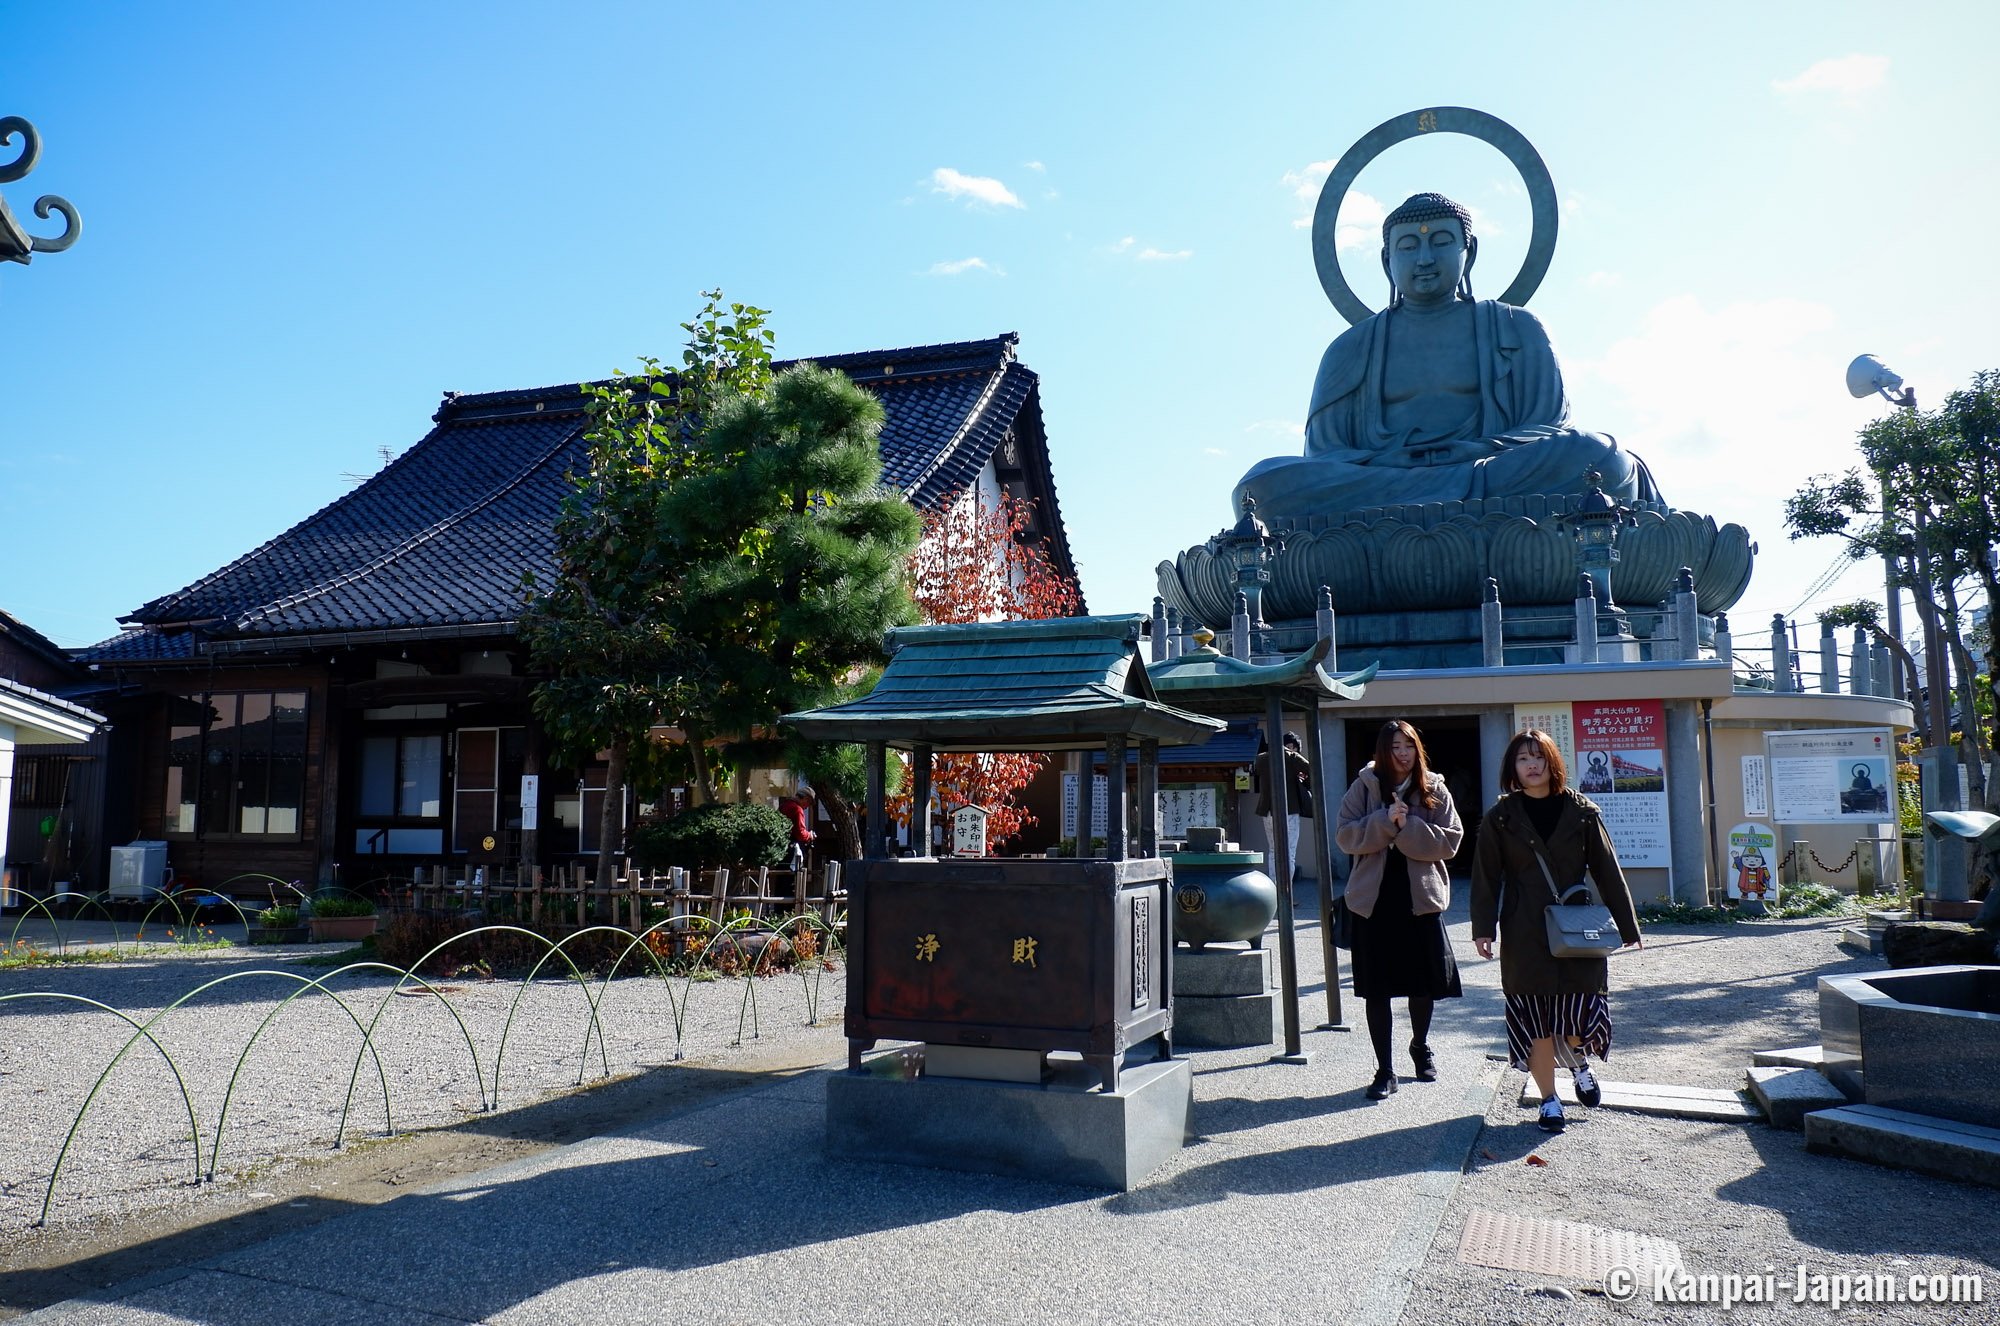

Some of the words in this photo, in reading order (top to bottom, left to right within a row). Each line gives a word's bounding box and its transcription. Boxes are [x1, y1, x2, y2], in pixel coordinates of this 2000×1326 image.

[1594, 707, 1641, 715] 高岡大仏祭り
[1581, 716, 1654, 726] 御芳名入り提灯
[1587, 726, 1649, 735] 協賛のお願い
[957, 813, 967, 837] お守
[970, 813, 981, 842] 御朱印
